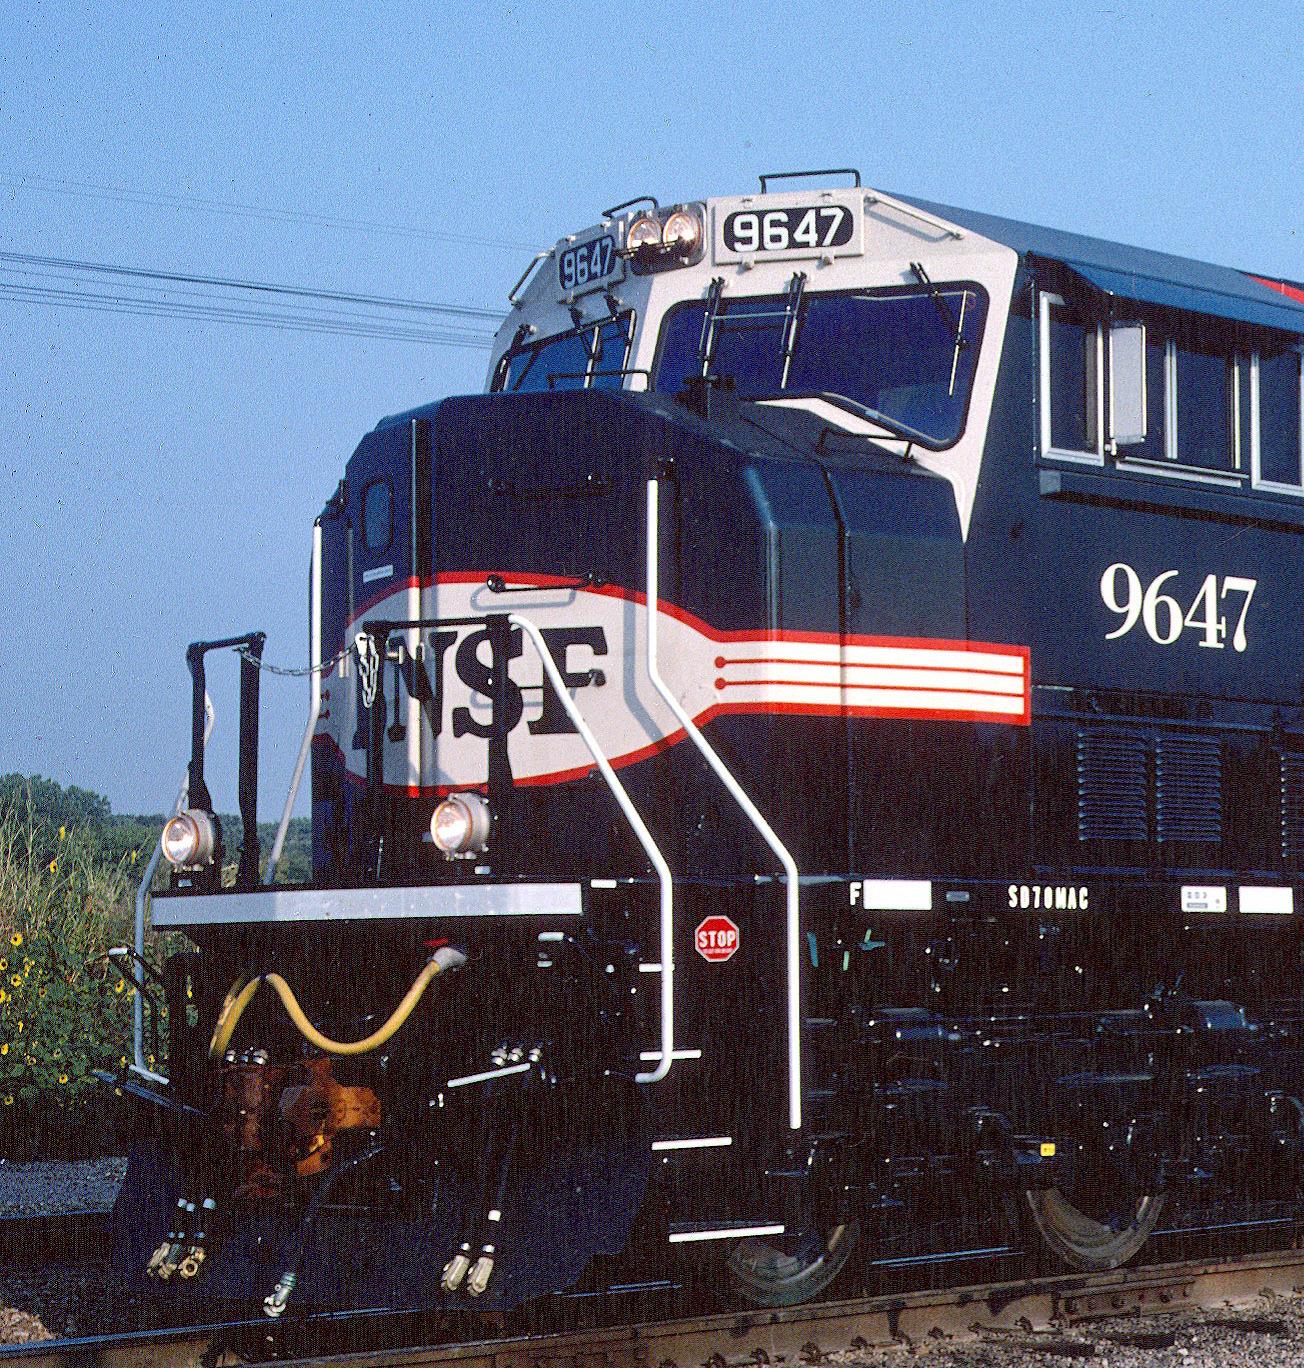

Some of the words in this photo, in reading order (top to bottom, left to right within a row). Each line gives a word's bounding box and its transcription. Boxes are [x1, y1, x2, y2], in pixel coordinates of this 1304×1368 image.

[733, 207, 844, 252] 9647
[563, 238, 612, 288] 9647
[1100, 563, 1257, 652] 9647
[850, 882, 862, 905] F
[1008, 885, 1089, 910] SD70MAC
[699, 930, 736, 948] STOP
